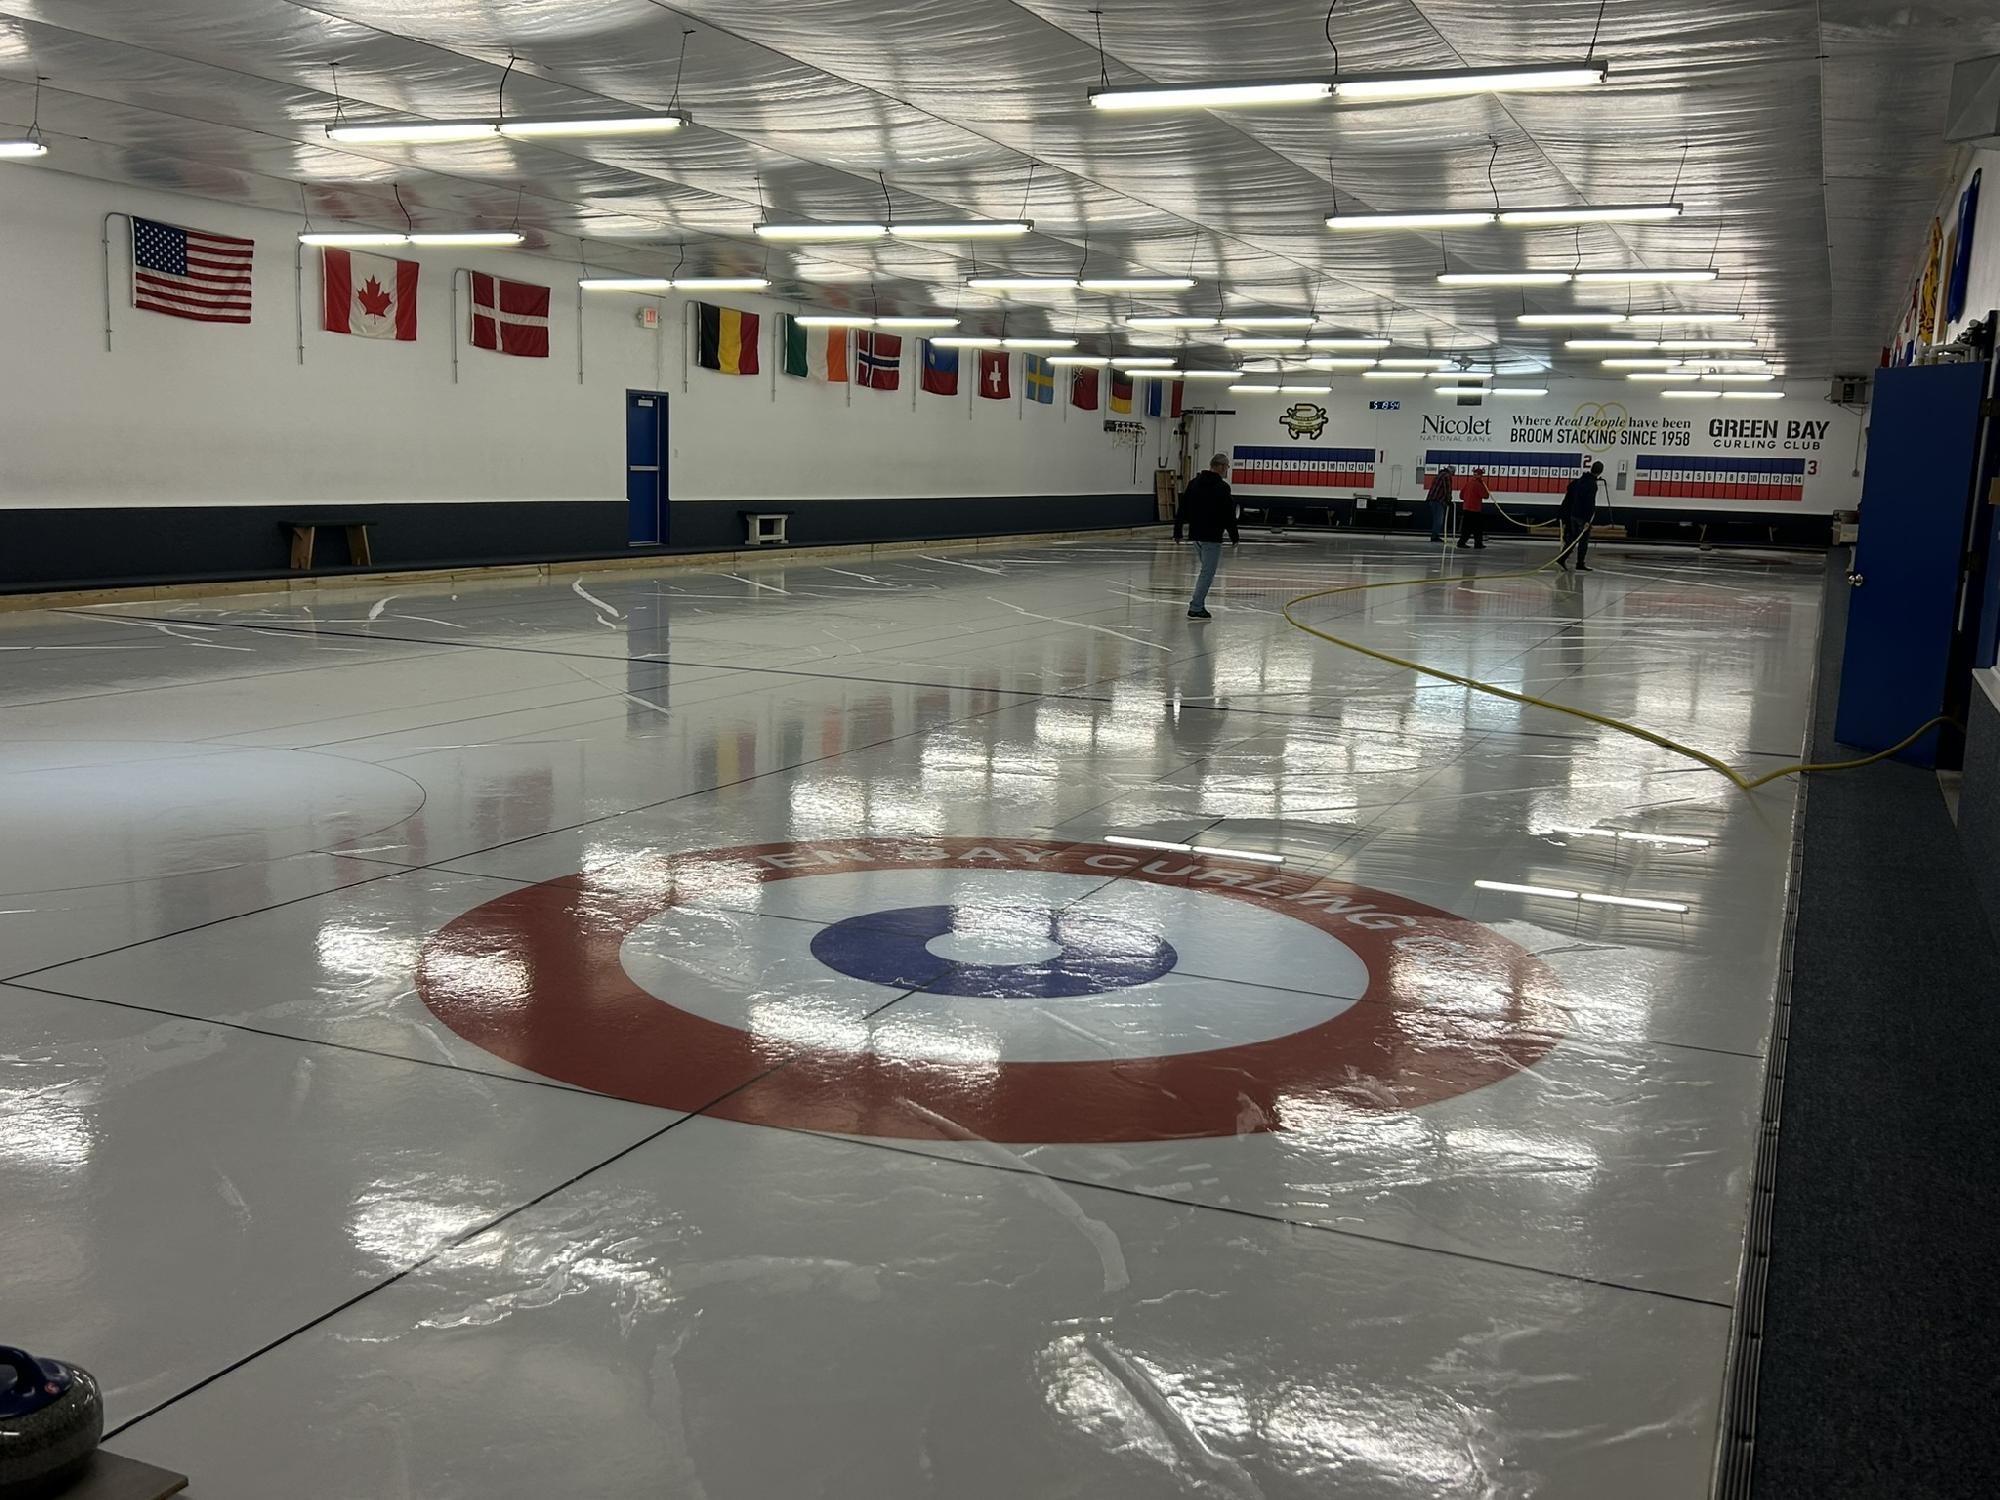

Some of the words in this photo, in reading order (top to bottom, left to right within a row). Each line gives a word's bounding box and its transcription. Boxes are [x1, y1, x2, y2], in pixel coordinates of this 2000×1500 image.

[1421, 415, 1492, 435] Nicolet
[1512, 416, 1551, 426] Where
[1555, 416, 1582, 426] Real
[1585, 416, 1625, 429] People
[1629, 417, 1658, 428] have
[1662, 418, 1691, 428] been
[1709, 419, 1778, 438] GREEN
[1787, 420, 1830, 439] BAY
[1510, 429, 1553, 443] BROOM
[1557, 429, 1616, 444] STACKING
[1620, 430, 1657, 445] SINCE
[1662, 431, 1690, 446] 1958
[1713, 439, 1776, 449] CURLING
[1784, 441, 1821, 450] CLUB
[1583, 455, 1592, 468] 2
[1807, 460, 1817, 475] 3
[1084, 854, 1417, 930] CURLING
